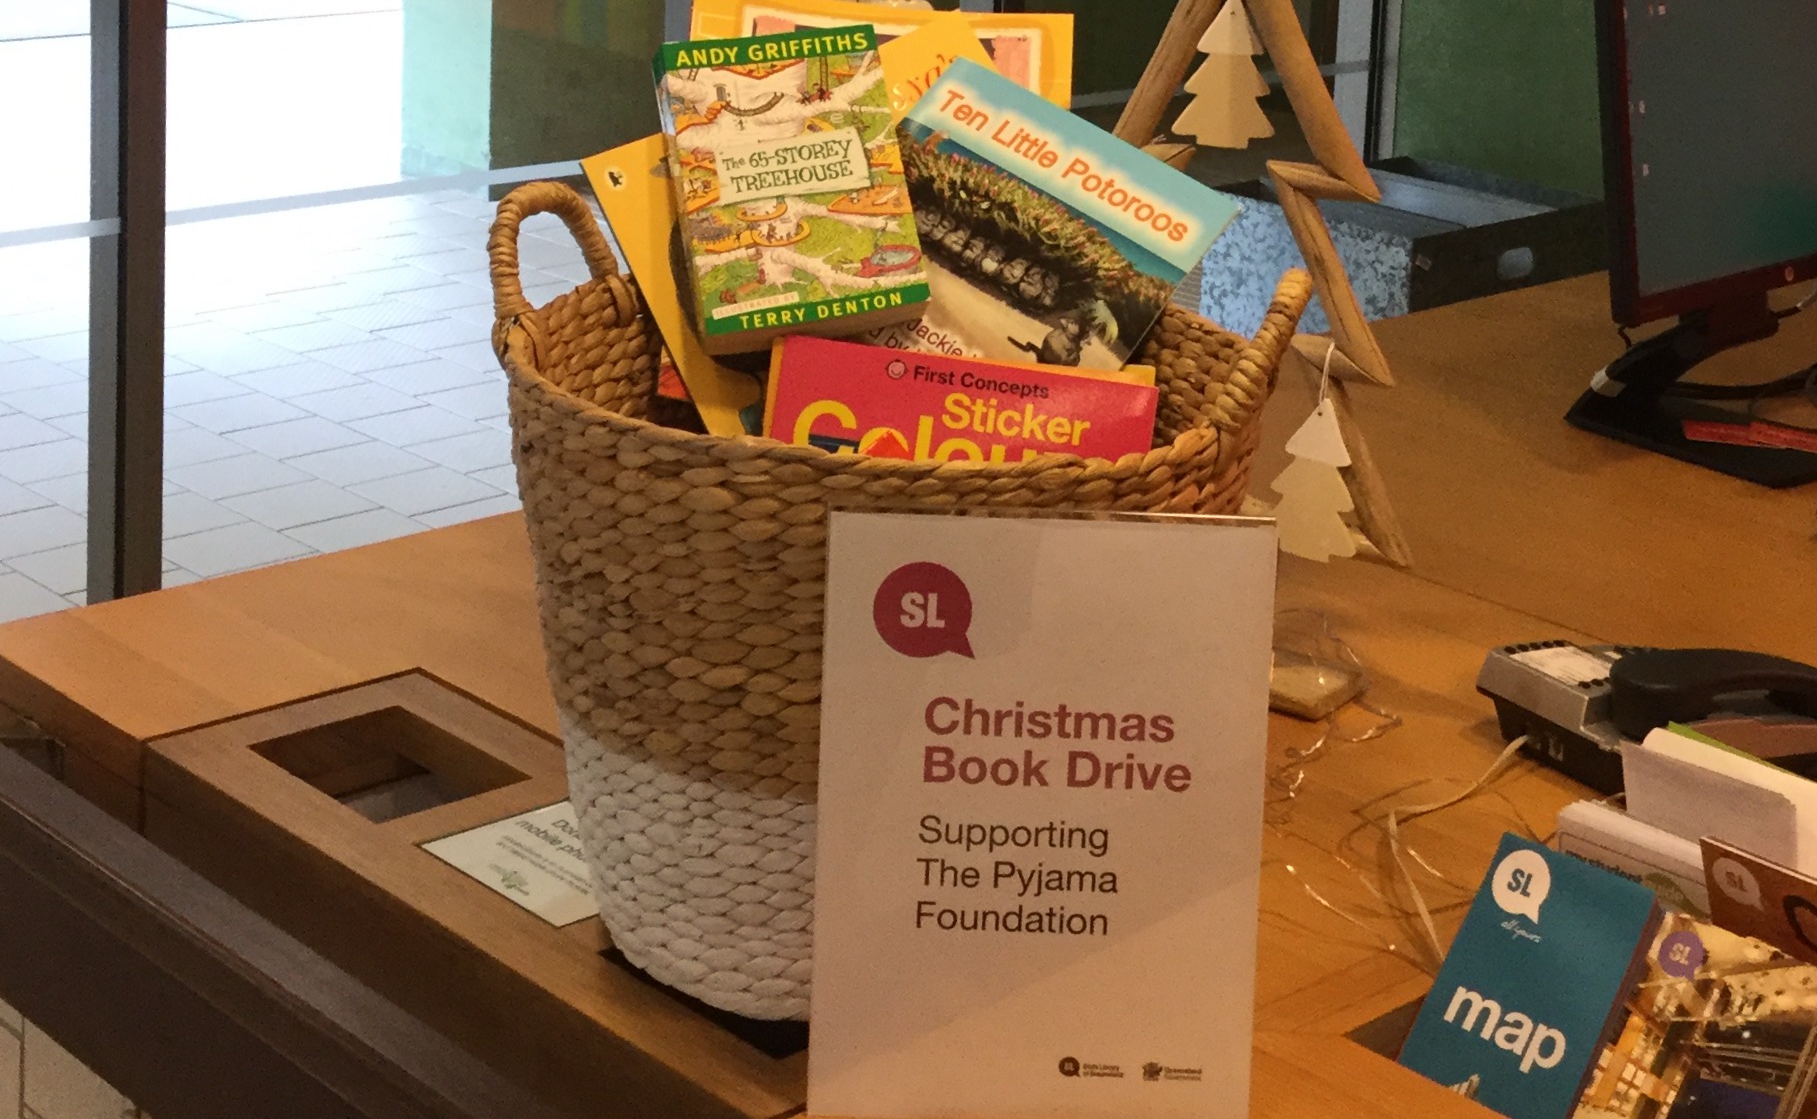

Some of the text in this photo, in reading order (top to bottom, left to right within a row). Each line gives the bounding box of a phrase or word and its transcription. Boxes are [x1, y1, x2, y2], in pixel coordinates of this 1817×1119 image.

[676, 32, 868, 67] ANDY GRIFFITHS
[722, 139, 853, 171] The 65-STOREY
[938, 89, 990, 132] Ten
[991, 119, 1060, 169] Little
[1061, 157, 1189, 243] Potoroos
[730, 160, 854, 193] TREEHOUSE
[740, 292, 902, 329] TERRY DENTON
[906, 318, 963, 356] Jackie
[913, 365, 1050, 399] First Concepts
[942, 392, 1090, 446] Sticker
[900, 592, 945, 628] SL
[924, 696, 1176, 743] Christmas
[922, 745, 1192, 793] Book Drive
[918, 815, 1110, 857] Supporting
[917, 858, 1118, 896] The Pyjama
[1507, 868, 1533, 898] SL
[916, 901, 1109, 936] Foundation
[1669, 942, 1691, 965] SL
[1443, 986, 1567, 1073] map
